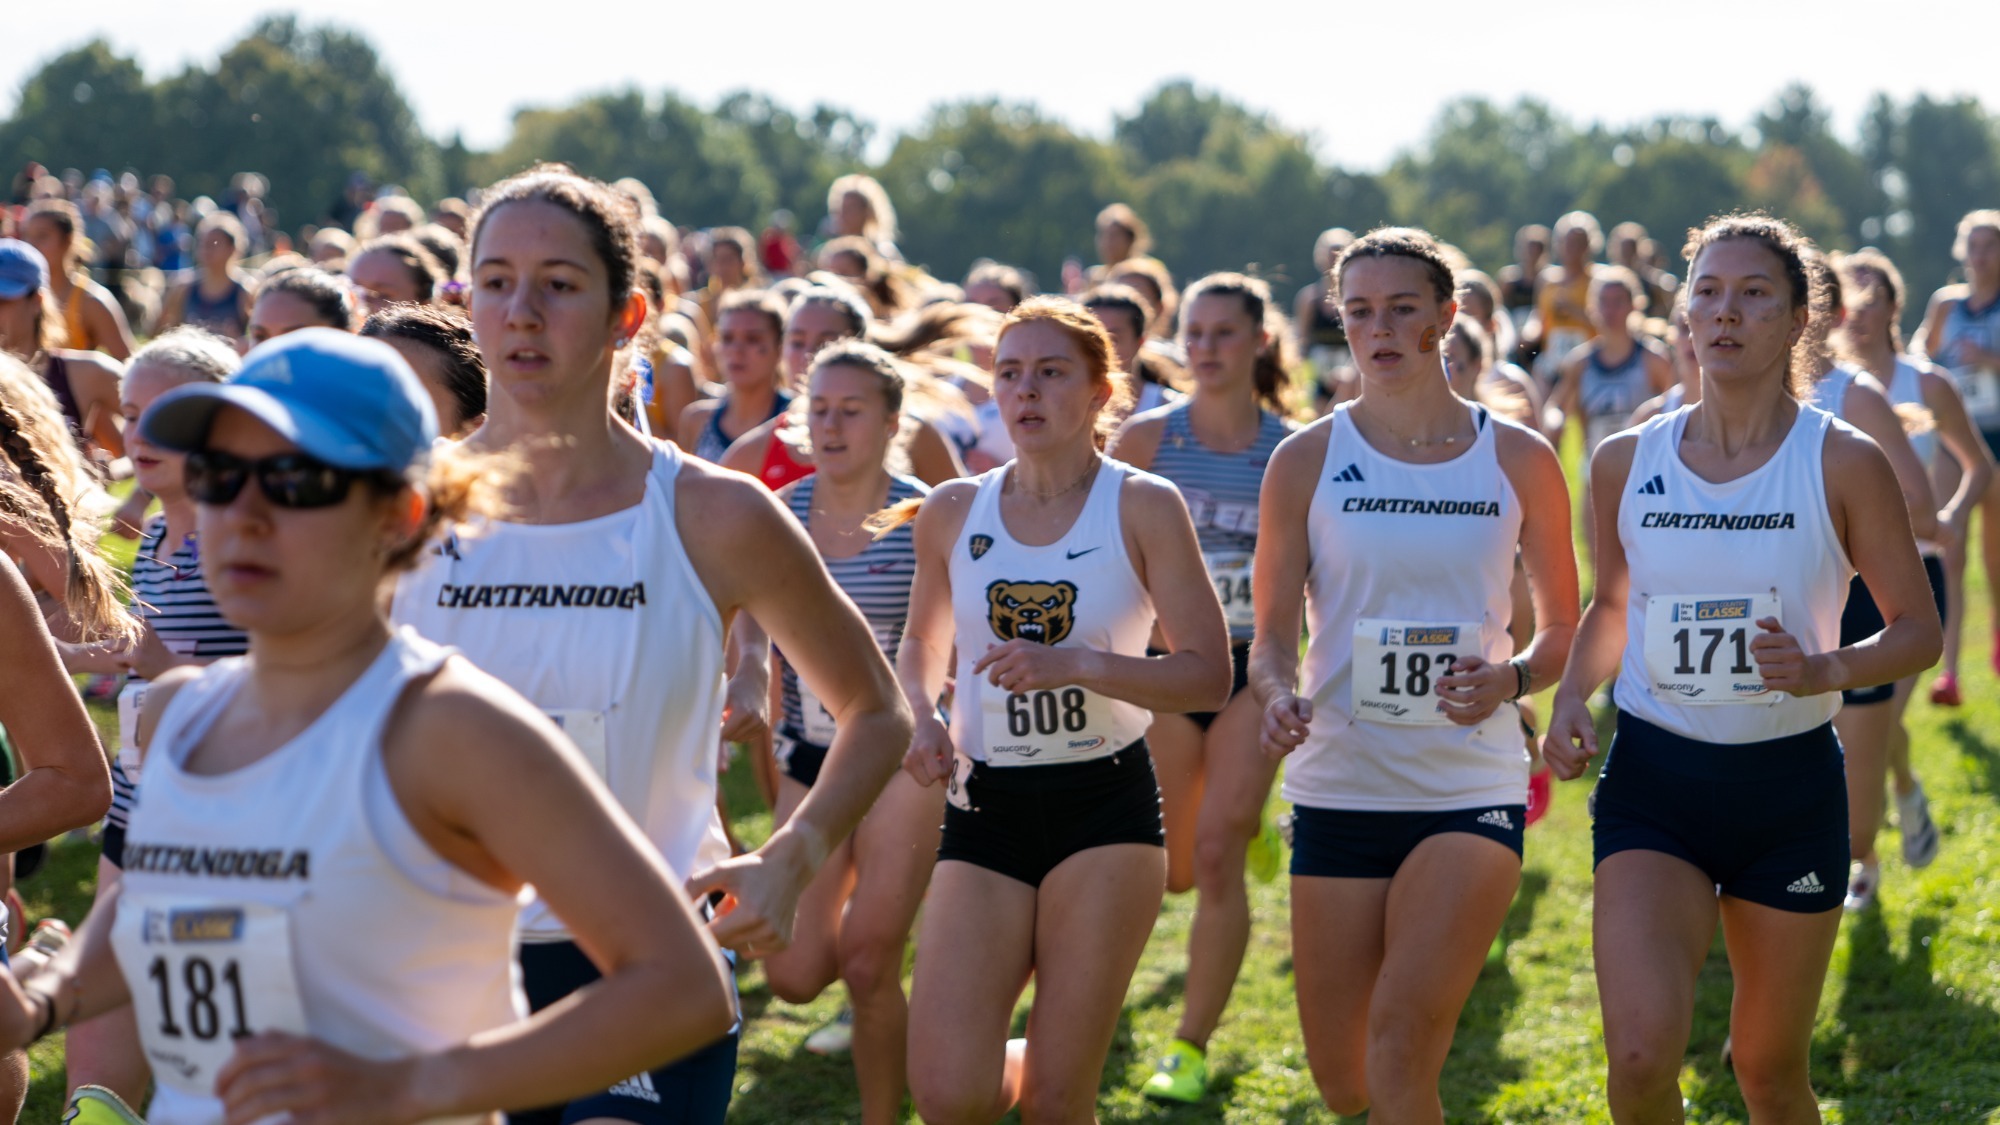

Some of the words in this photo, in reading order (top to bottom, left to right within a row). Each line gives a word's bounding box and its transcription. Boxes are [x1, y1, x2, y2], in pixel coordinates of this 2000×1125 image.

[1342, 497, 1500, 517] CHATTANOOGA
[1641, 512, 1795, 530] CHATTANOOGA
[437, 581, 647, 610] CHATTANOOGA
[1698, 606, 1746, 619] CLASSIC
[1406, 633, 1454, 645] CLASSIC
[1673, 627, 1753, 675] 171
[1656, 681, 1695, 692] saucony
[1006, 687, 1087, 738] 608
[1360, 699, 1400, 712] saucony
[992, 744, 1031, 753] saucony
[1067, 737, 1100, 749] Swags
[1476, 815, 1514, 831] adidas
[1786, 884, 1825, 894] adidas
[149, 955, 254, 1042] 181
[608, 1084, 661, 1104] adidas
